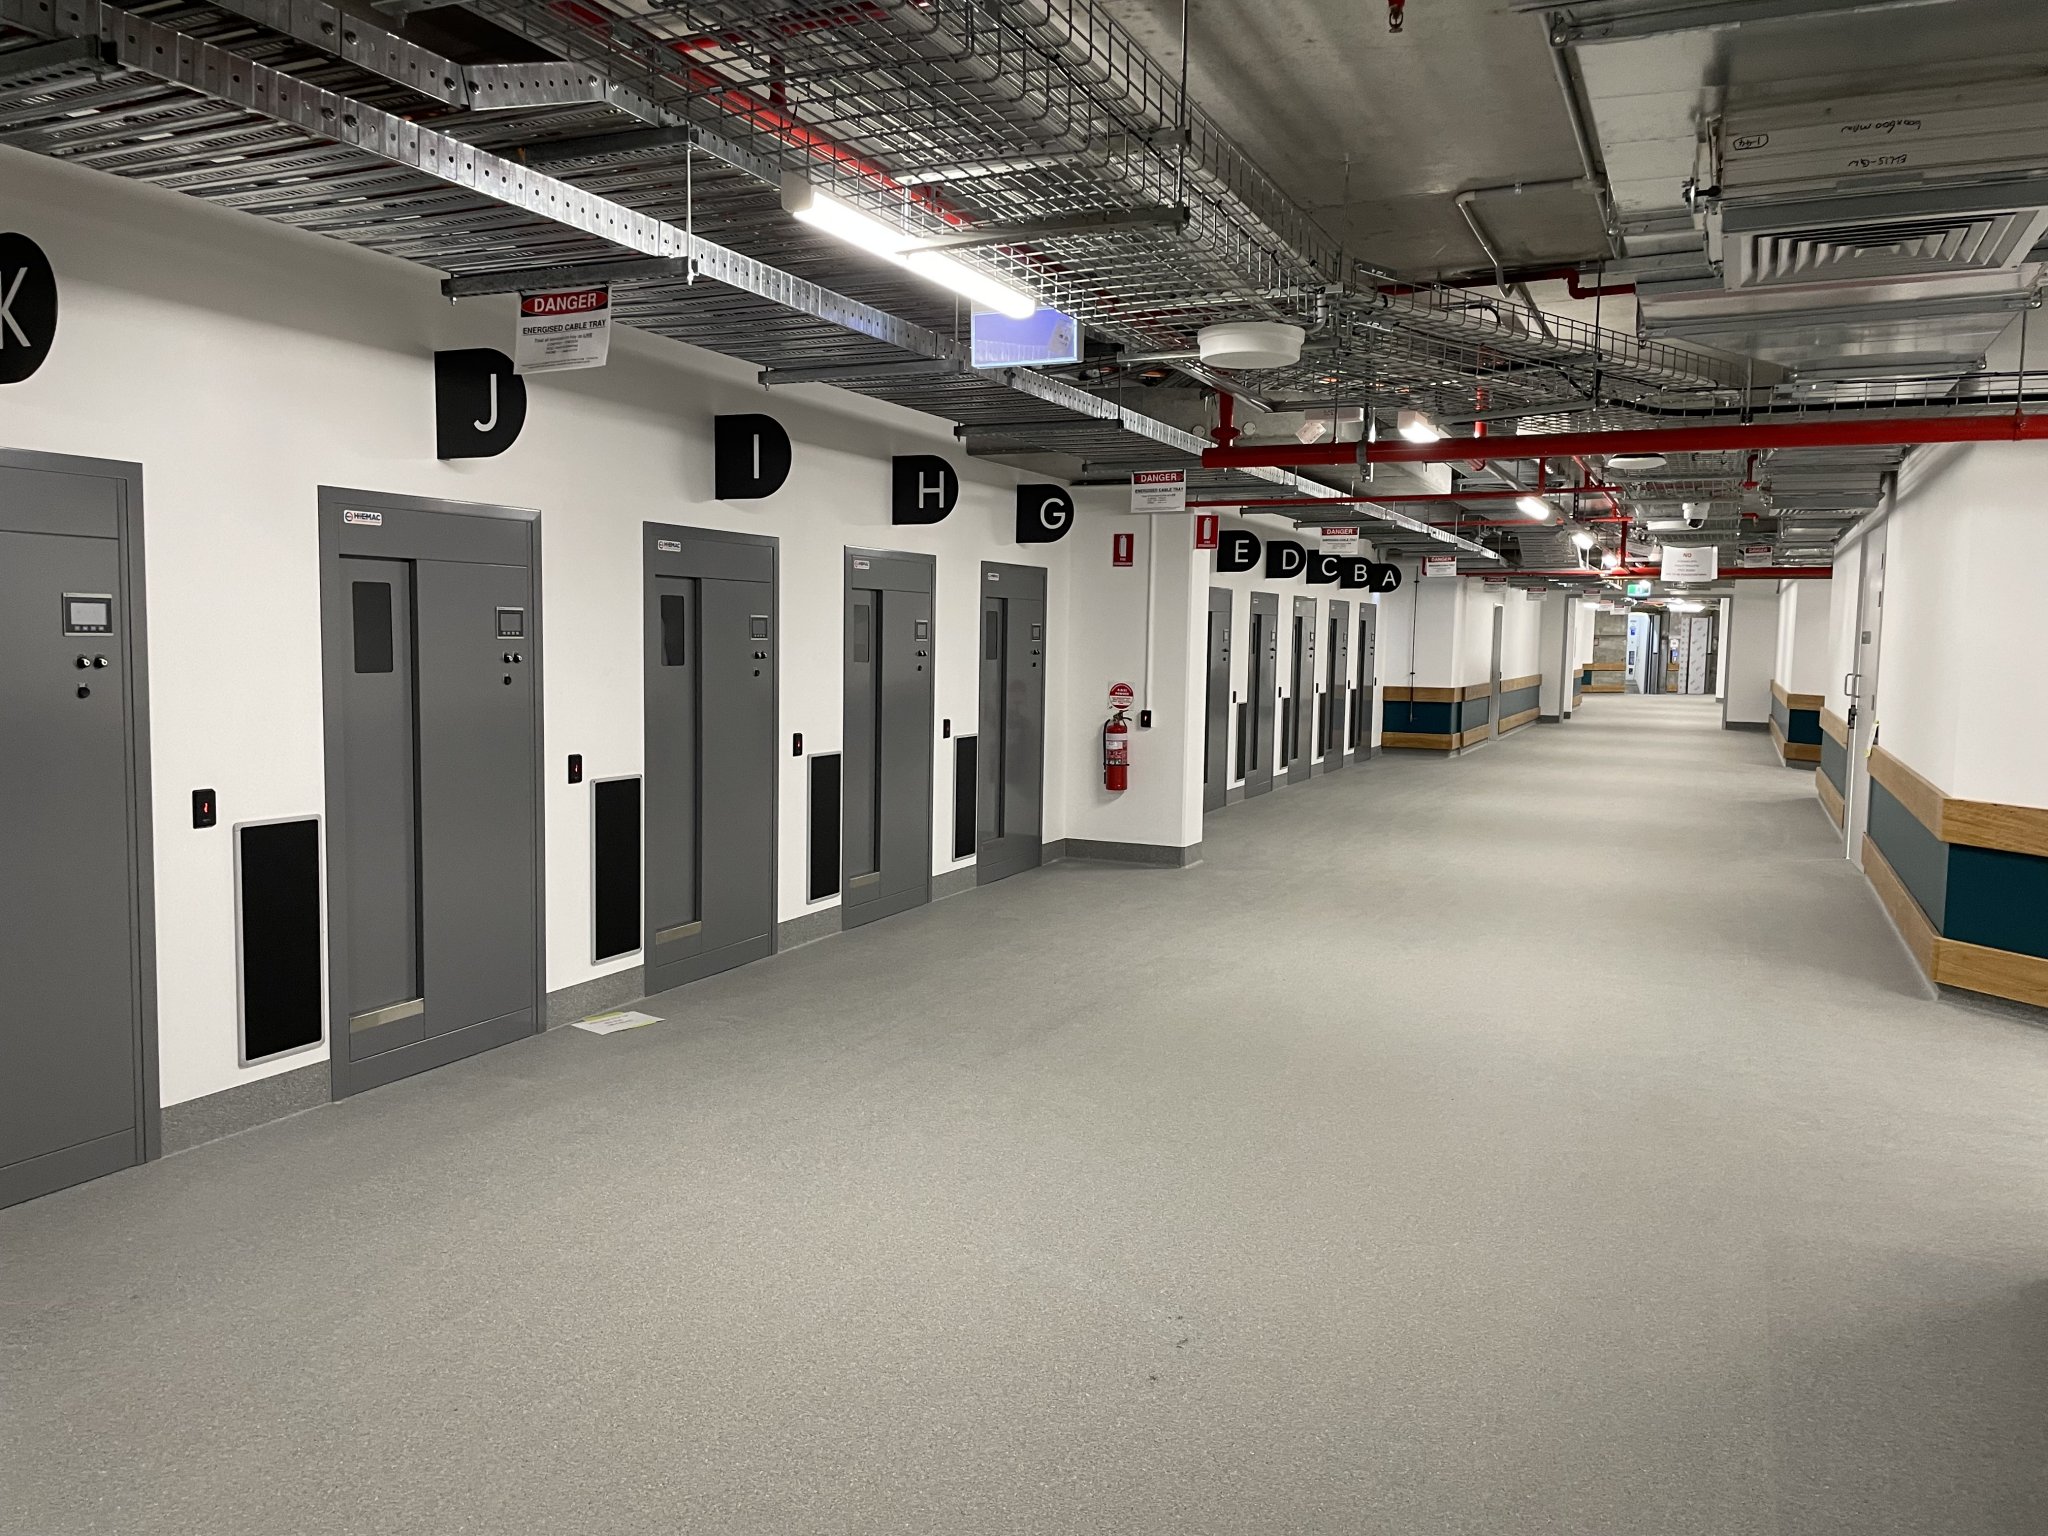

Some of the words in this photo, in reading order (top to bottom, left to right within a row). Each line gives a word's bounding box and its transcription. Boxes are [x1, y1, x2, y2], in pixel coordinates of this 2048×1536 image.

[0, 267, 32, 350] K
[534, 293, 597, 313] DANGER
[522, 325, 563, 335] ENERGISED
[564, 321, 588, 332] CABLE
[589, 319, 606, 328] TRAY
[474, 373, 498, 432] J
[753, 433, 760, 479] I
[1140, 473, 1177, 482] DANGER
[918, 470, 945, 509] H
[1040, 497, 1066, 530] G
[1234, 539, 1250, 563] E
[1282, 549, 1300, 570] D
[1321, 557, 1338, 576] C
[1354, 564, 1368, 582] B
[1381, 570, 1397, 587] A
